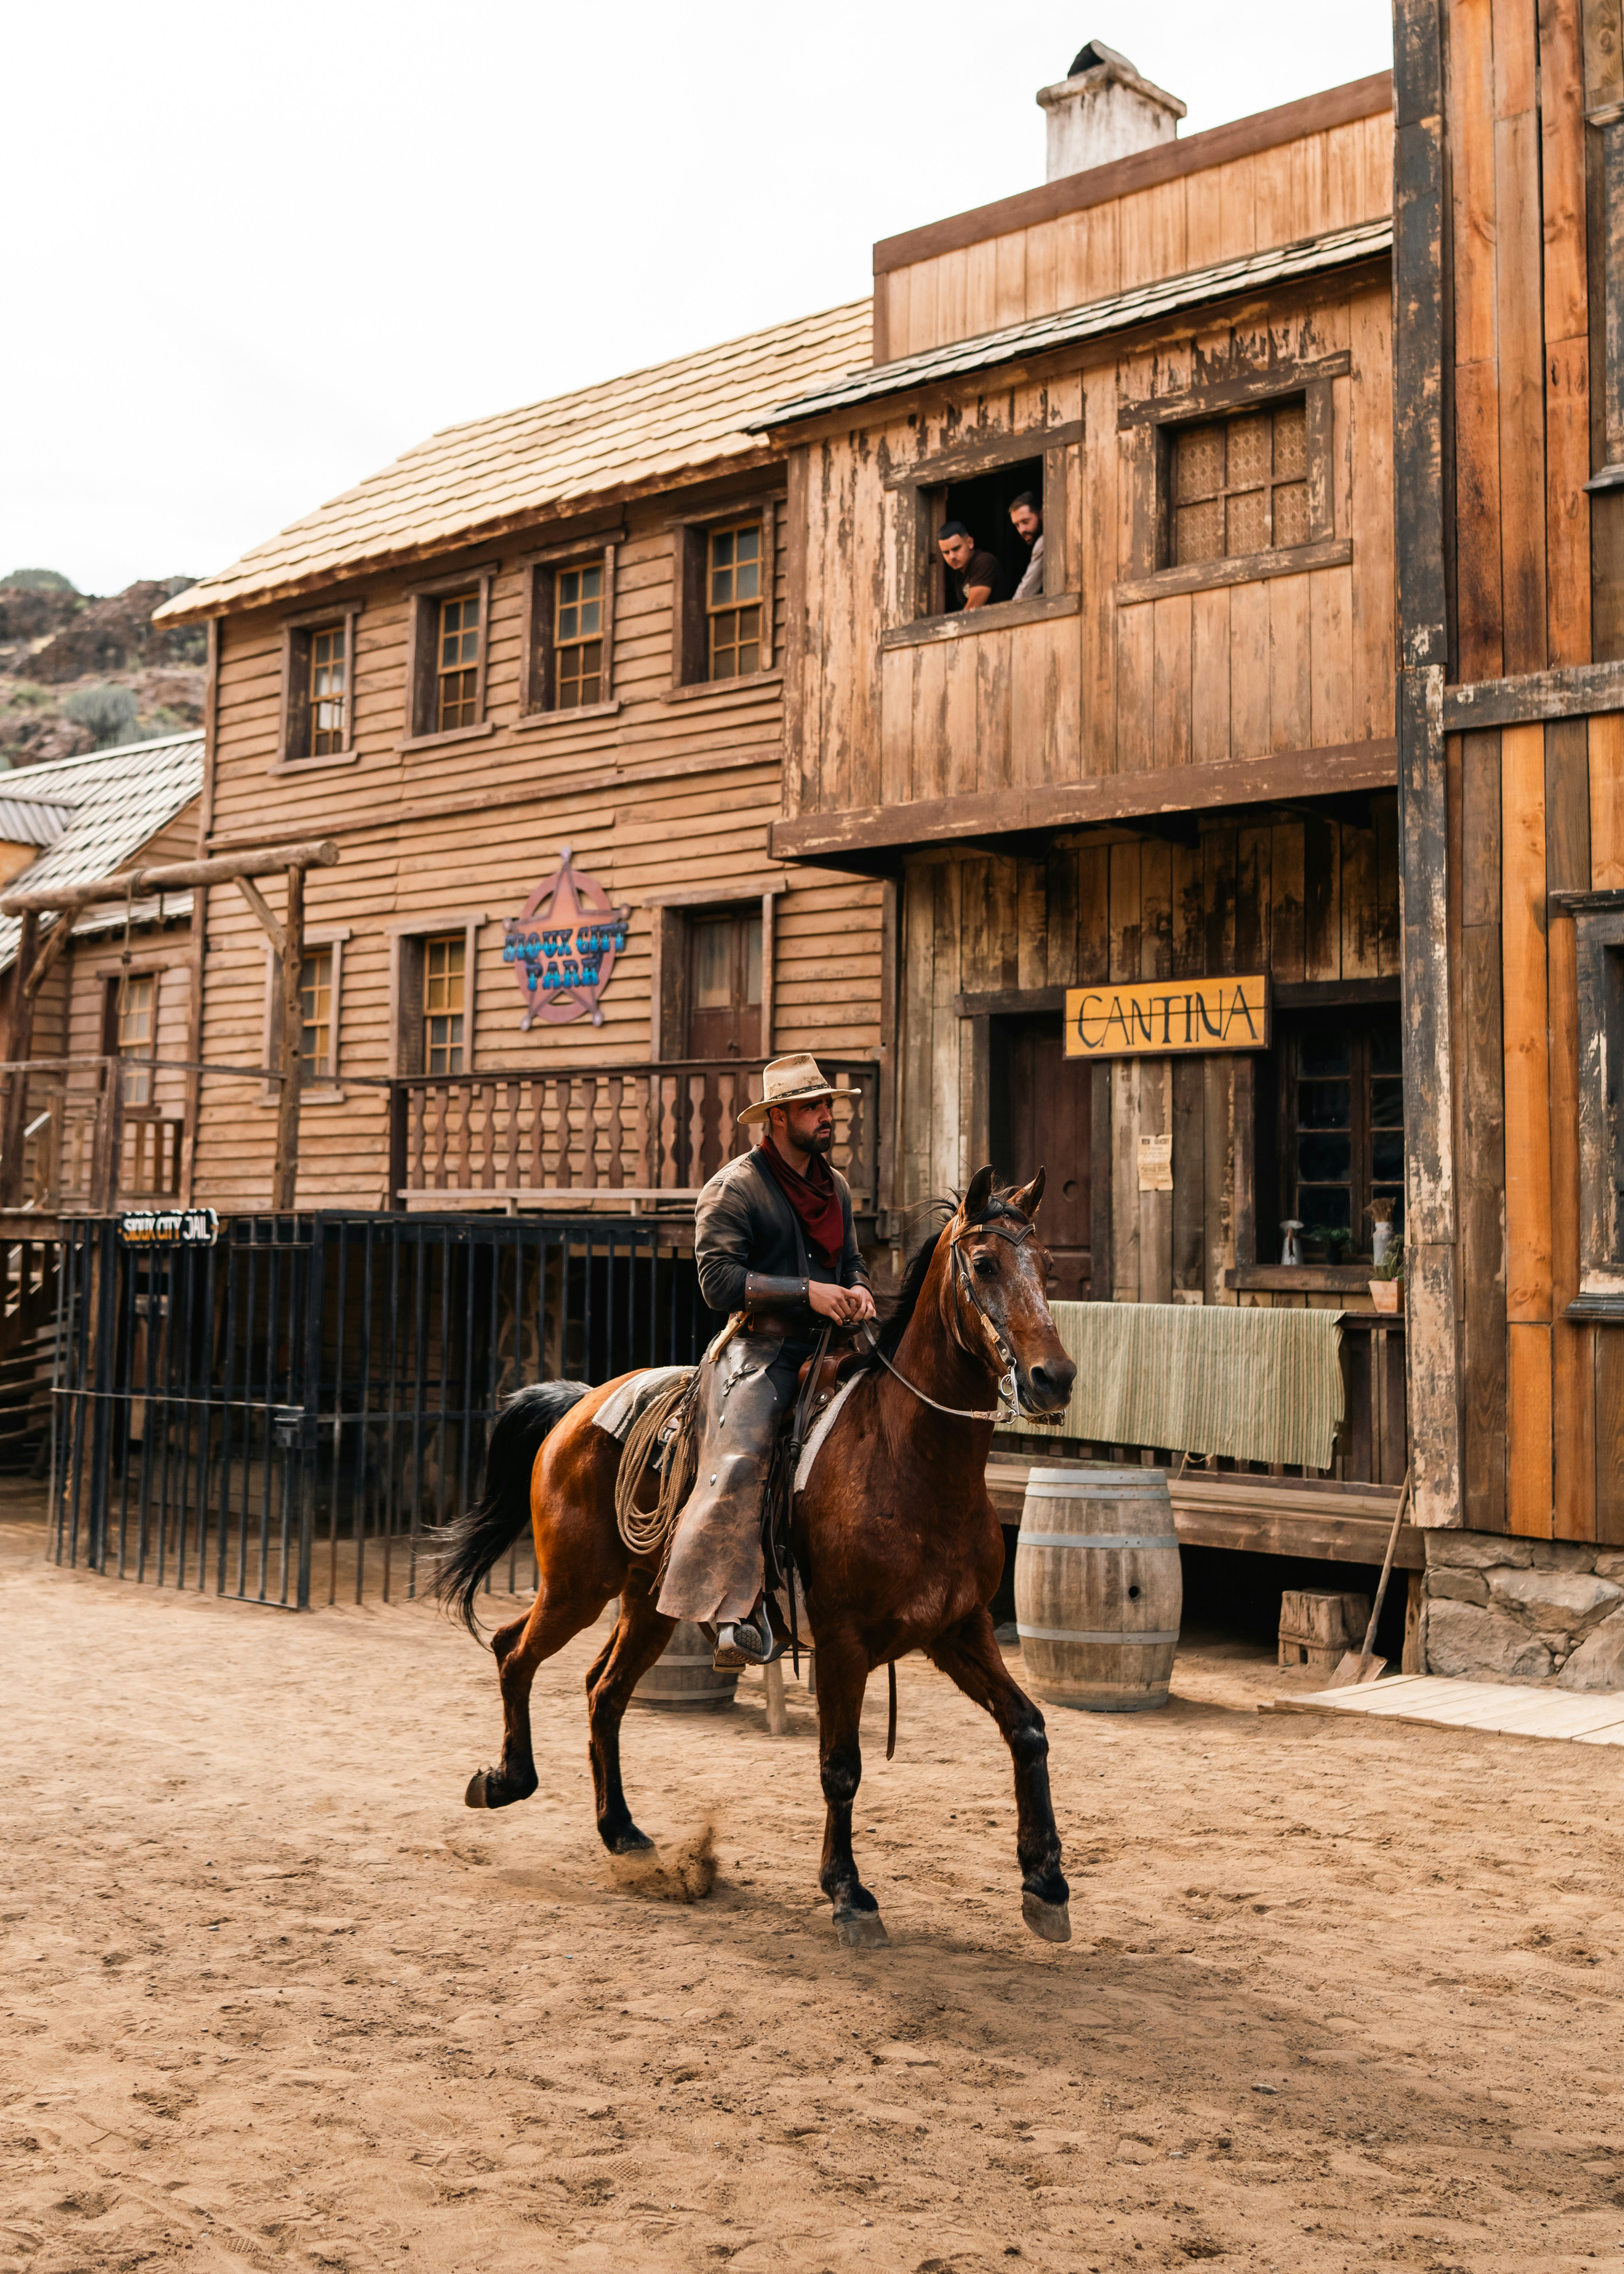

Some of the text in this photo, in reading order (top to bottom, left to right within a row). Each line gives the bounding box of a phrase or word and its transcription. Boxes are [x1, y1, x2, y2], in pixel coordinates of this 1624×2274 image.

[503, 922, 629, 962] SIOUX CITY
[525, 958, 600, 991] PARK
[1078, 985, 1258, 1048] CANTINA
[123, 1215, 210, 1241] SIOUX CITY JAIL
